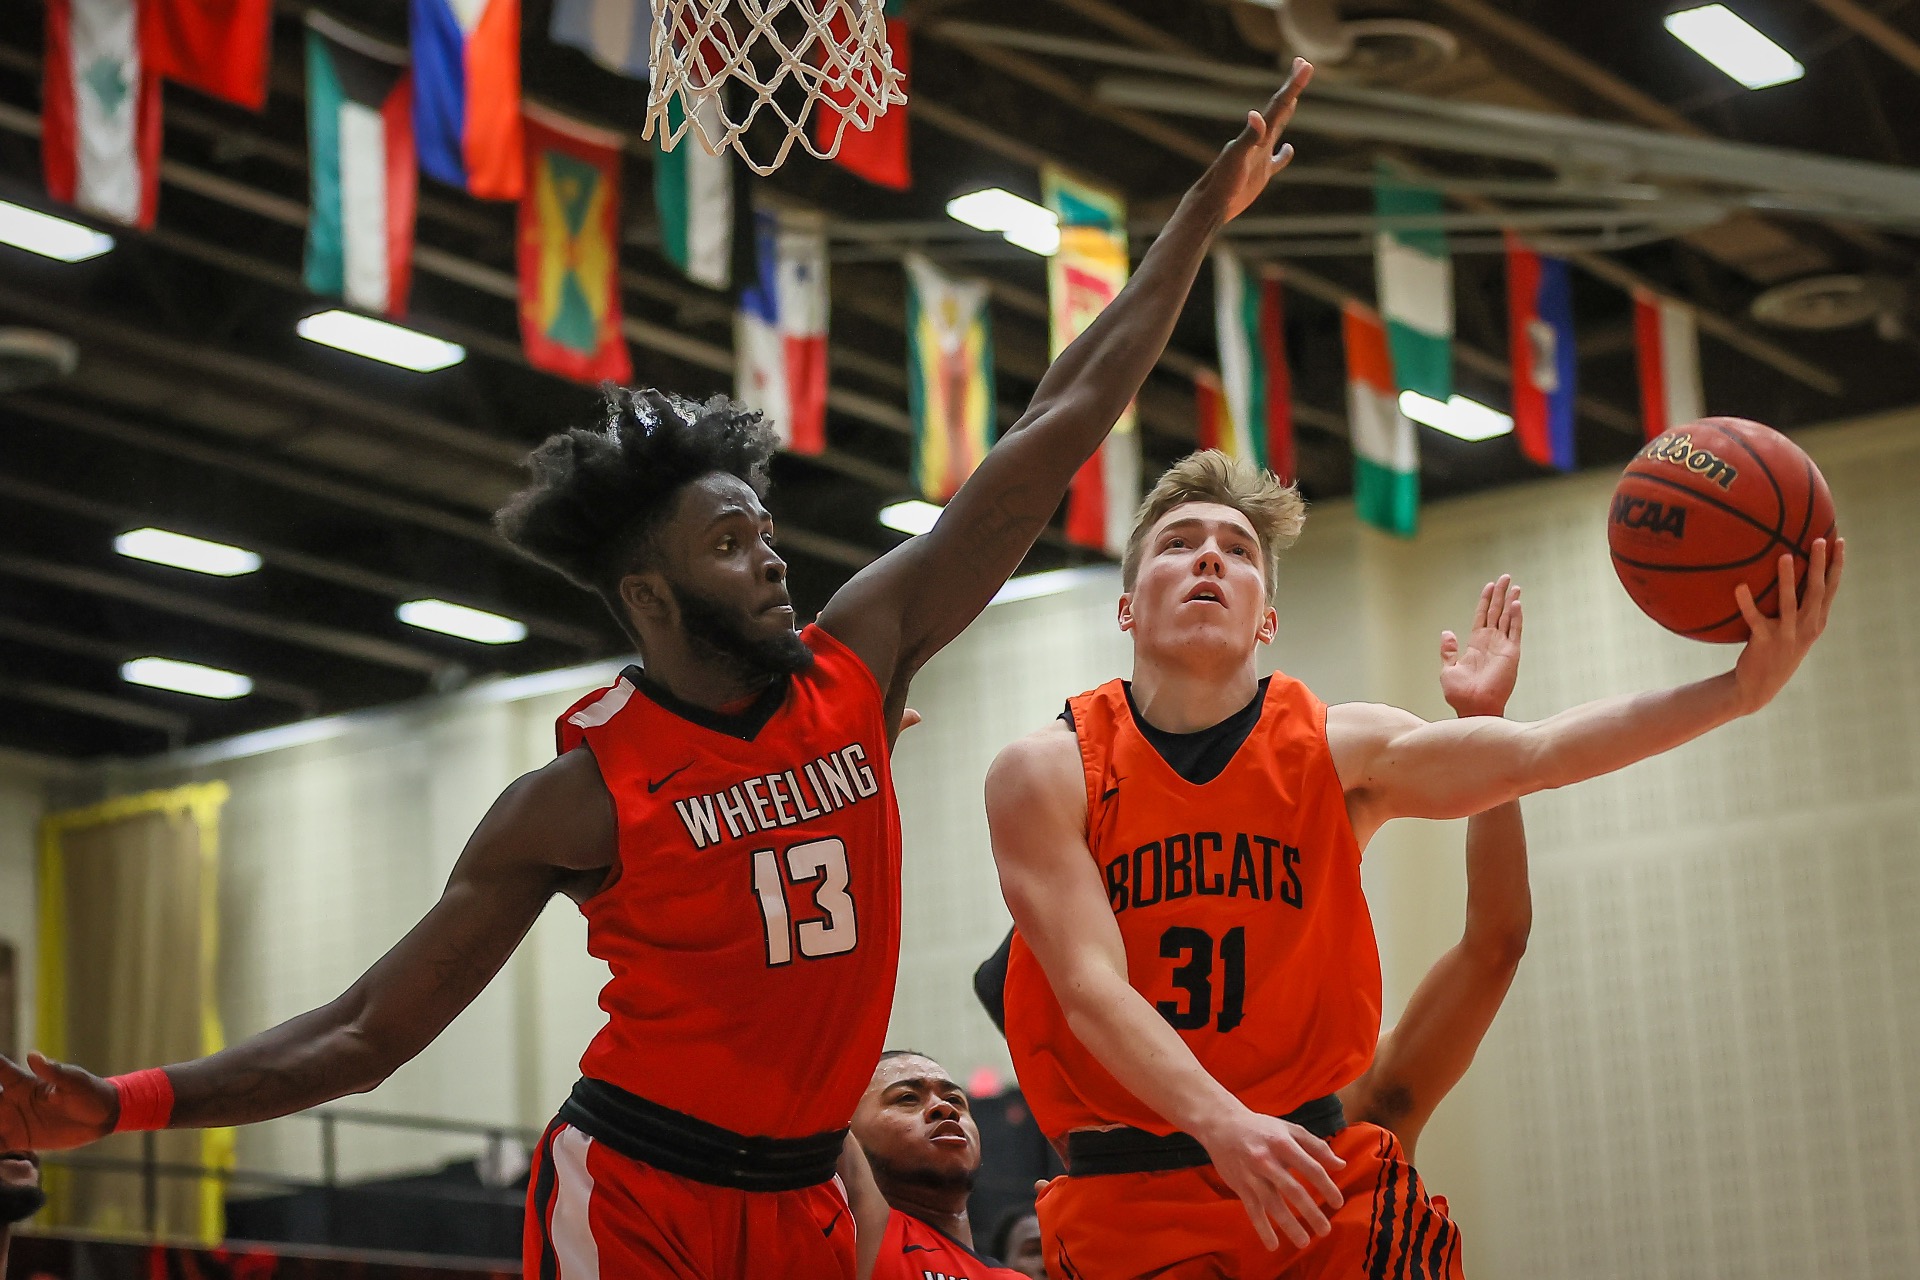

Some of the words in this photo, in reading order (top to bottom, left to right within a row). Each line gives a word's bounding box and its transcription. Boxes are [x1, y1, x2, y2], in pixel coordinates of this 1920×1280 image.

[1635, 433, 1738, 492] ilson
[1613, 493, 1686, 539] NCAA
[673, 742, 880, 850] WHEELING
[752, 835, 859, 968] 13
[1105, 831, 1303, 916] BOBCATS
[1156, 925, 1246, 1033] 31
